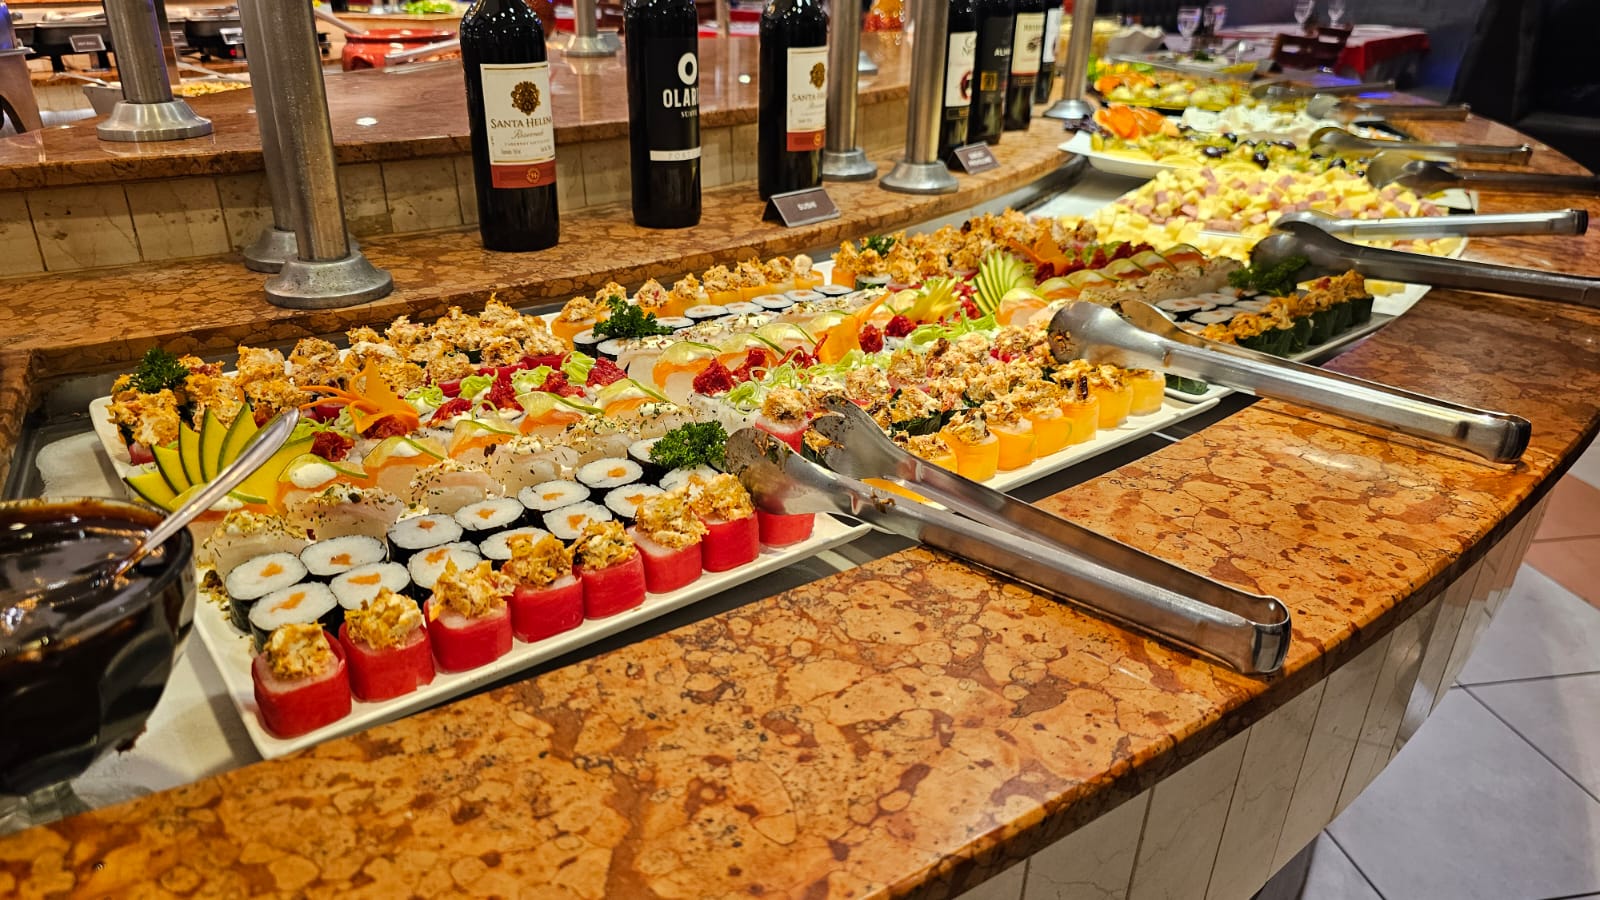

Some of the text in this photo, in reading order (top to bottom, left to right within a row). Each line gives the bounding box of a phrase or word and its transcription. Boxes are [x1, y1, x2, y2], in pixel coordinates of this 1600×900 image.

[663, 88, 699, 107] OLAR
[792, 93, 816, 102] SANTA
[490, 116, 552, 128] SANTA HELEN
